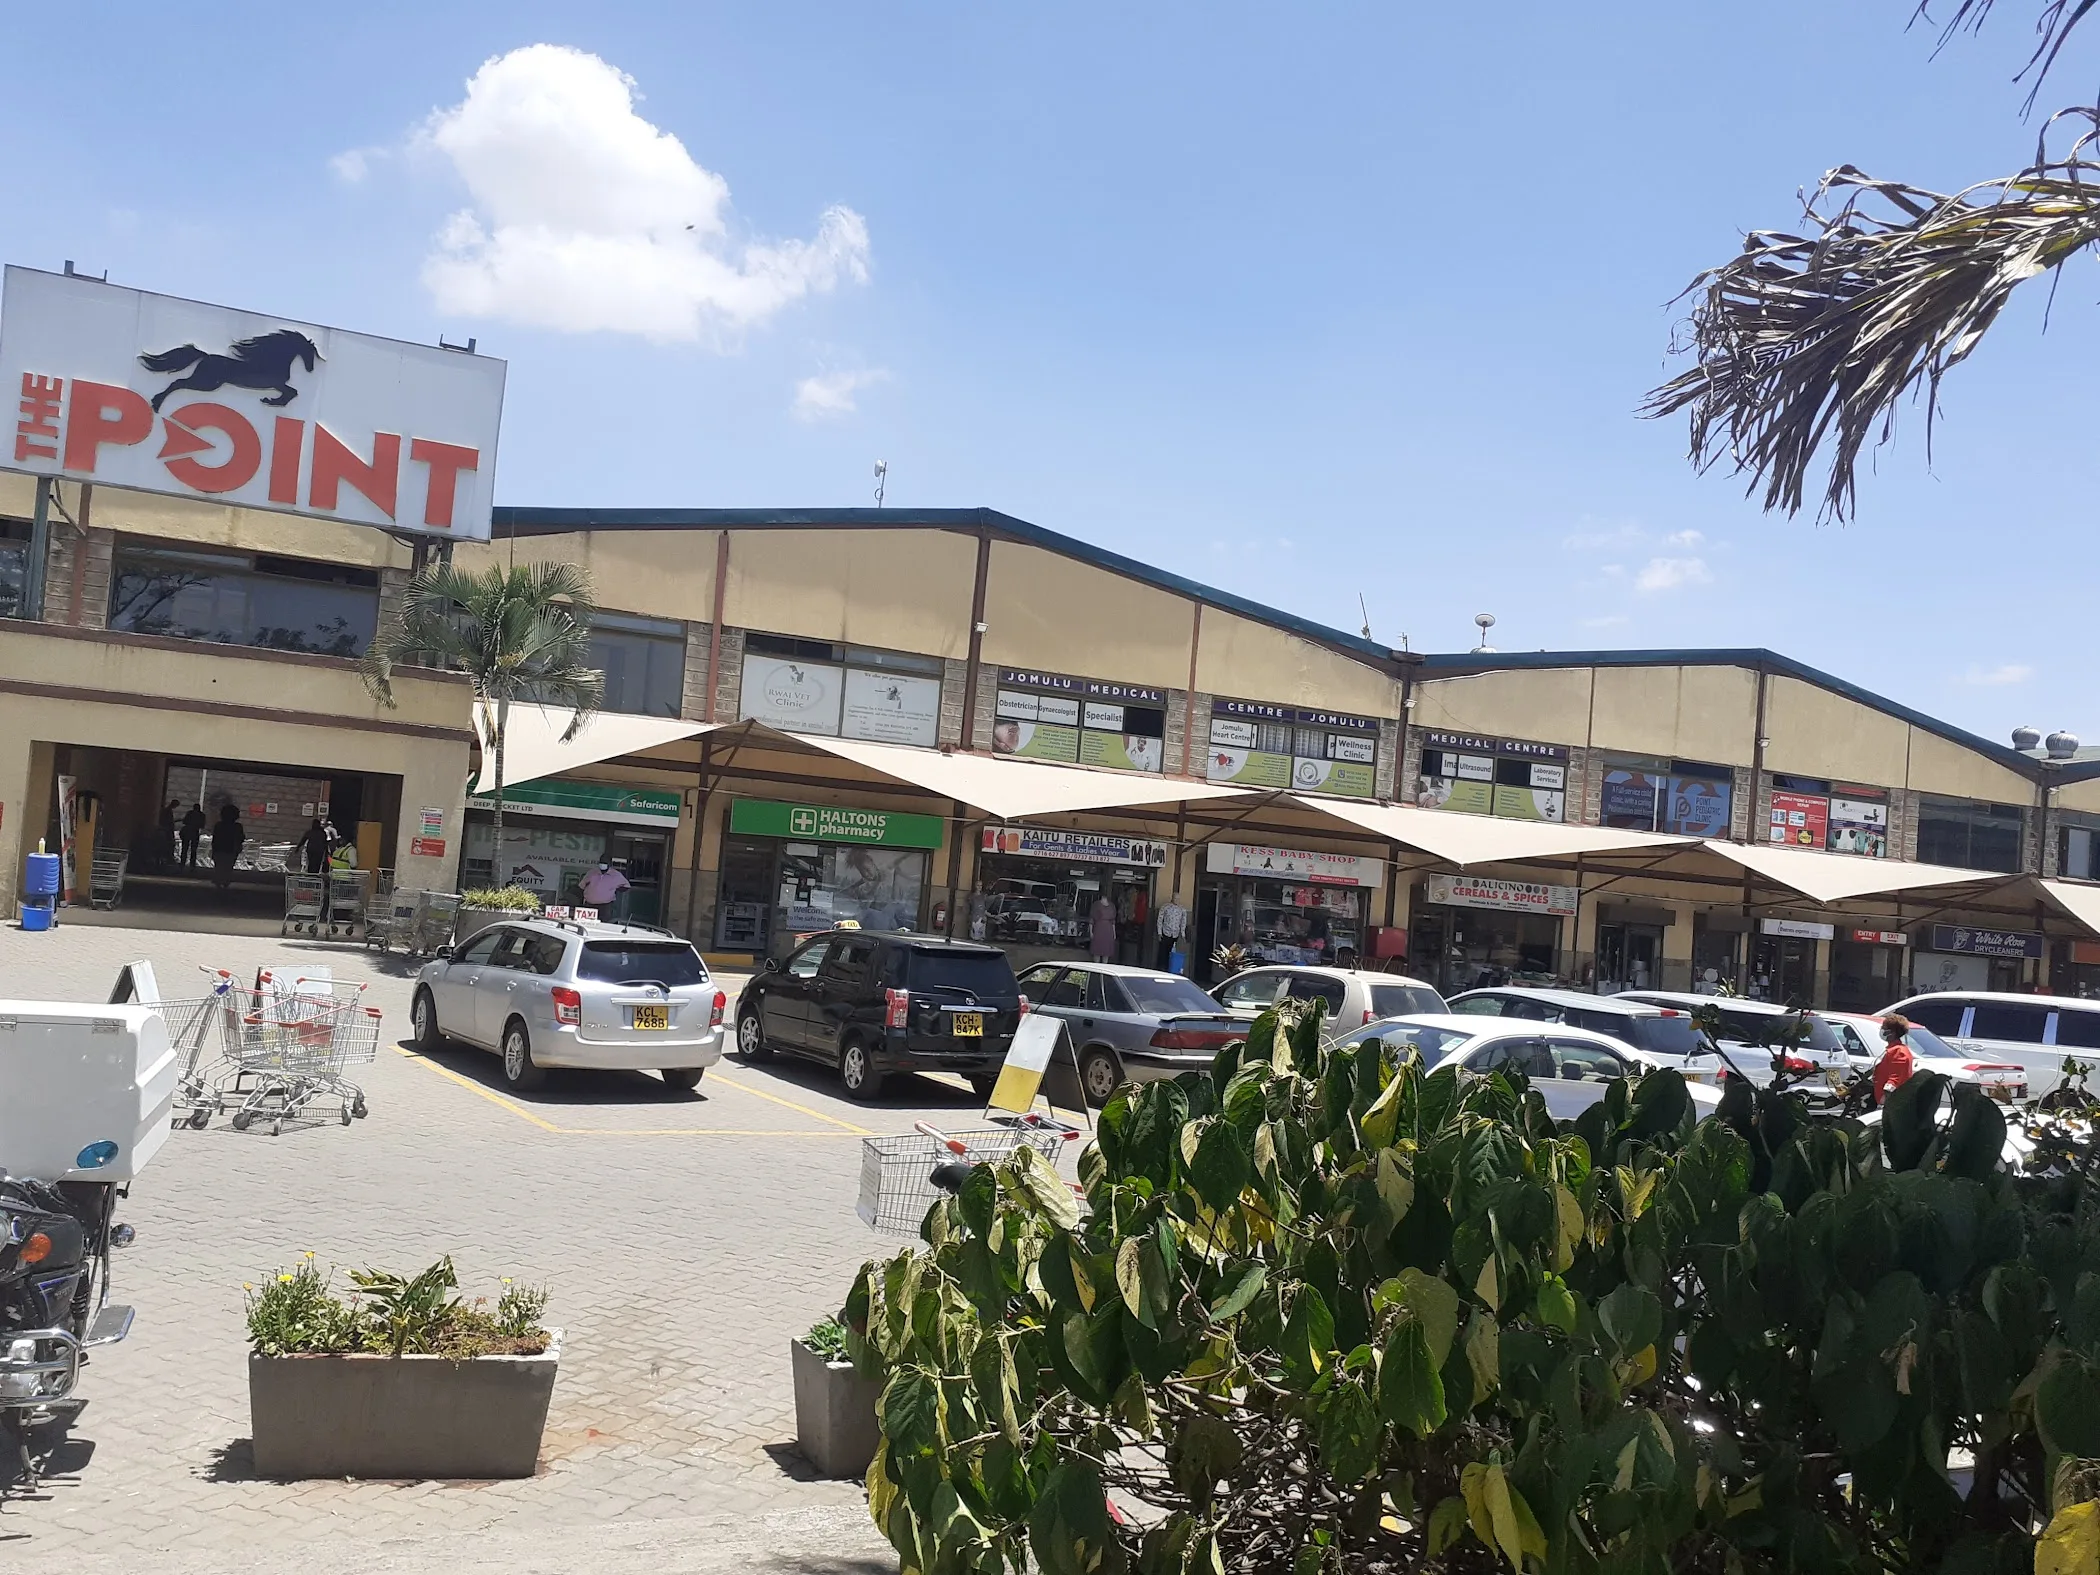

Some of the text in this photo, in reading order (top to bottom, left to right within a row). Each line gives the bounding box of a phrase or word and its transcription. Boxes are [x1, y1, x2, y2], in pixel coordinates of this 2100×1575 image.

[14, 372, 64, 462] THE
[63, 378, 479, 527] POINT
[1008, 673, 1158, 700] JOMULU MEDICAL
[775, 698, 804, 708] Clinic
[999, 700, 1038, 711] Obstetrician
[1086, 710, 1122, 723] Specialist
[1227, 702, 1365, 728] CENTRE JOMULU
[1221, 723, 1243, 732] Jomulu
[1212, 731, 1250, 741] Heart Centre
[1338, 740, 1372, 750] Wellness
[1431, 734, 1555, 756] MEDICAL CENTRE
[1344, 751, 1364, 759] Clinic
[1460, 763, 1491, 773] Ultrasound
[1533, 767, 1561, 777] Laboratory
[1537, 776, 1558, 784] Services
[492, 803, 519, 811] CKET
[630, 799, 678, 811] Safaricom
[820, 810, 886, 827] HALTONS
[819, 822, 885, 840] pharmacy
[1023, 831, 1130, 849] KAITU RETAILERS
[1044, 843, 1064, 852] Gents
[1076, 846, 1097, 854] Ladies
[1100, 849, 1120, 857] Wear
[1240, 846, 1356, 864] KESS BABY SHOP
[526, 854, 576, 864] AVAILABLE
[511, 876, 545, 885] EQUITY
[1480, 881, 1524, 892] ALICINO
[1453, 887, 1498, 899] CEREALS
[1501, 891, 1509, 900] &
[1513, 893, 1549, 904] SPICES
[577, 910, 596, 919] TAXI
[1975, 932, 2026, 947] White Rose
[1975, 945, 2024, 956] DRYCLEANERS
[636, 1006, 658, 1017] KCL
[636, 1017, 665, 1028] 768B
[956, 1015, 974, 1024] KCH
[956, 1025, 980, 1034] 847K
